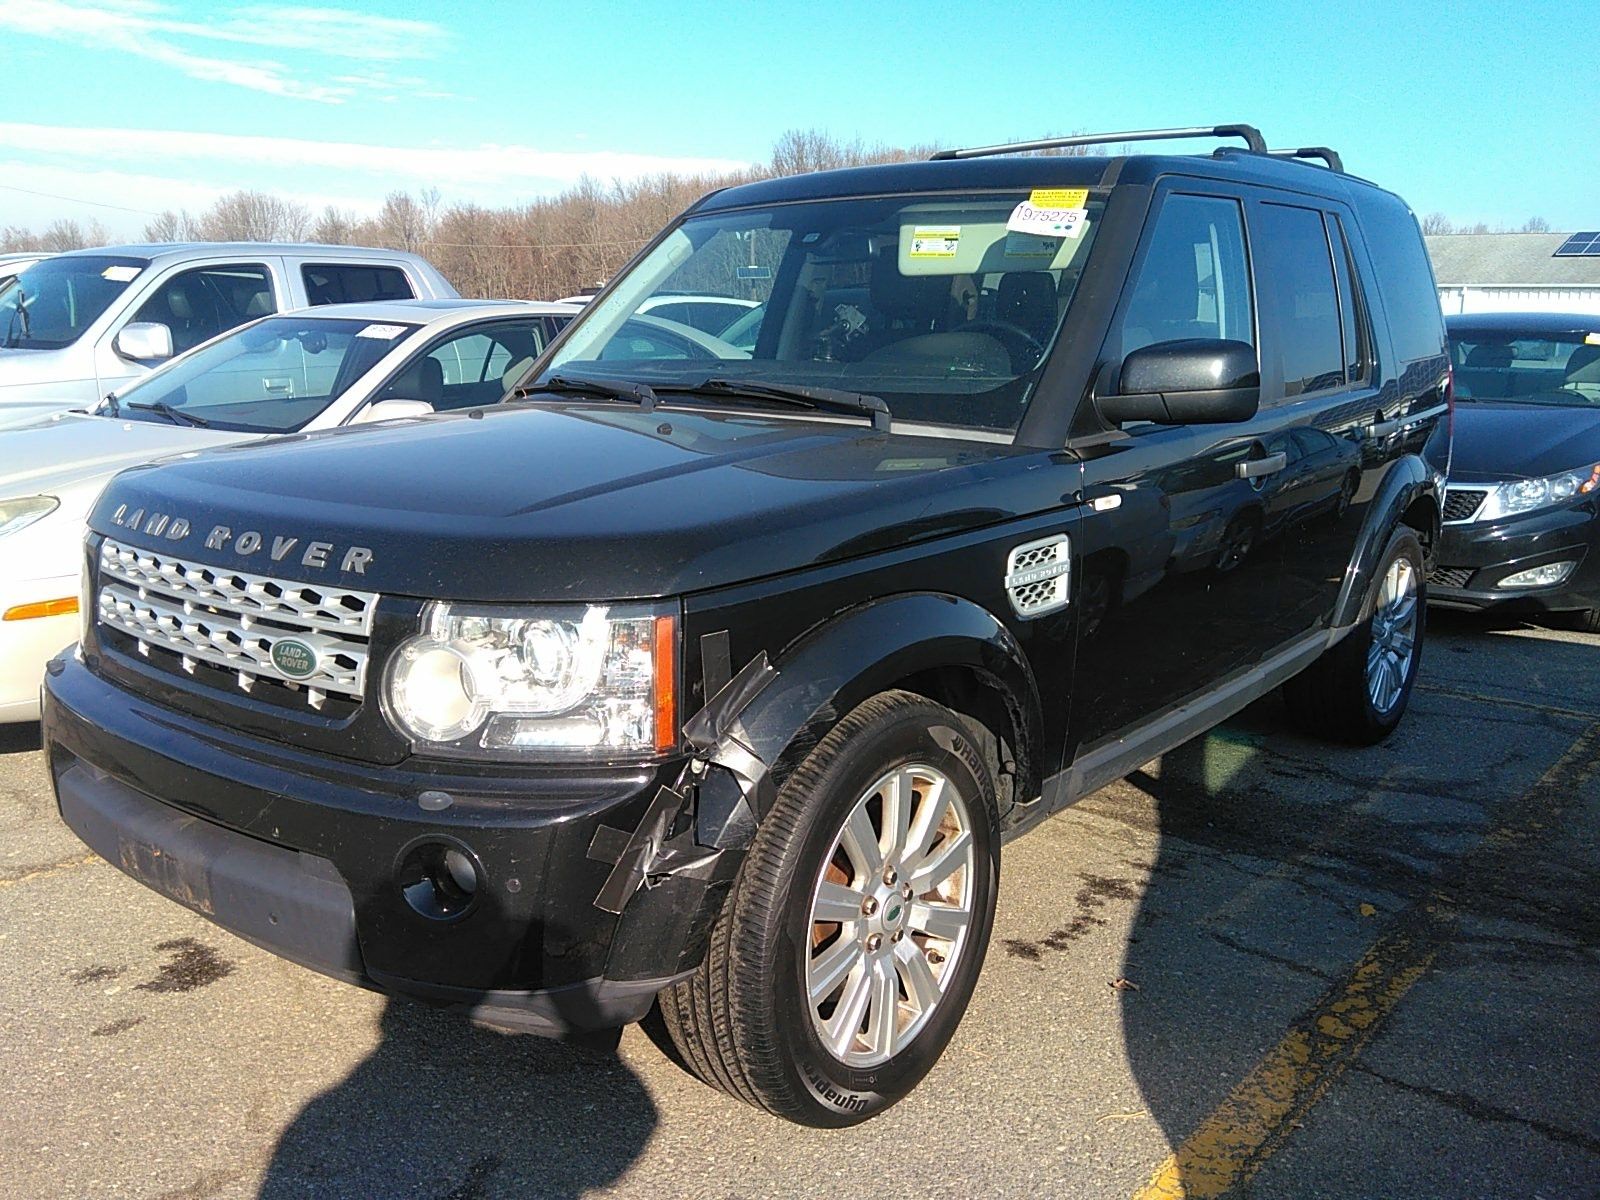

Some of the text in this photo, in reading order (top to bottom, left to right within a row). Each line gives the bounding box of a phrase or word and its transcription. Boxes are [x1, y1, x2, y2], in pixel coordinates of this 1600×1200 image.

[1016, 204, 1078, 222] 1975275
[110, 503, 373, 574] LAND ROVER
[280, 645, 302, 658] LAND
[281, 656, 309, 670] ROVER
